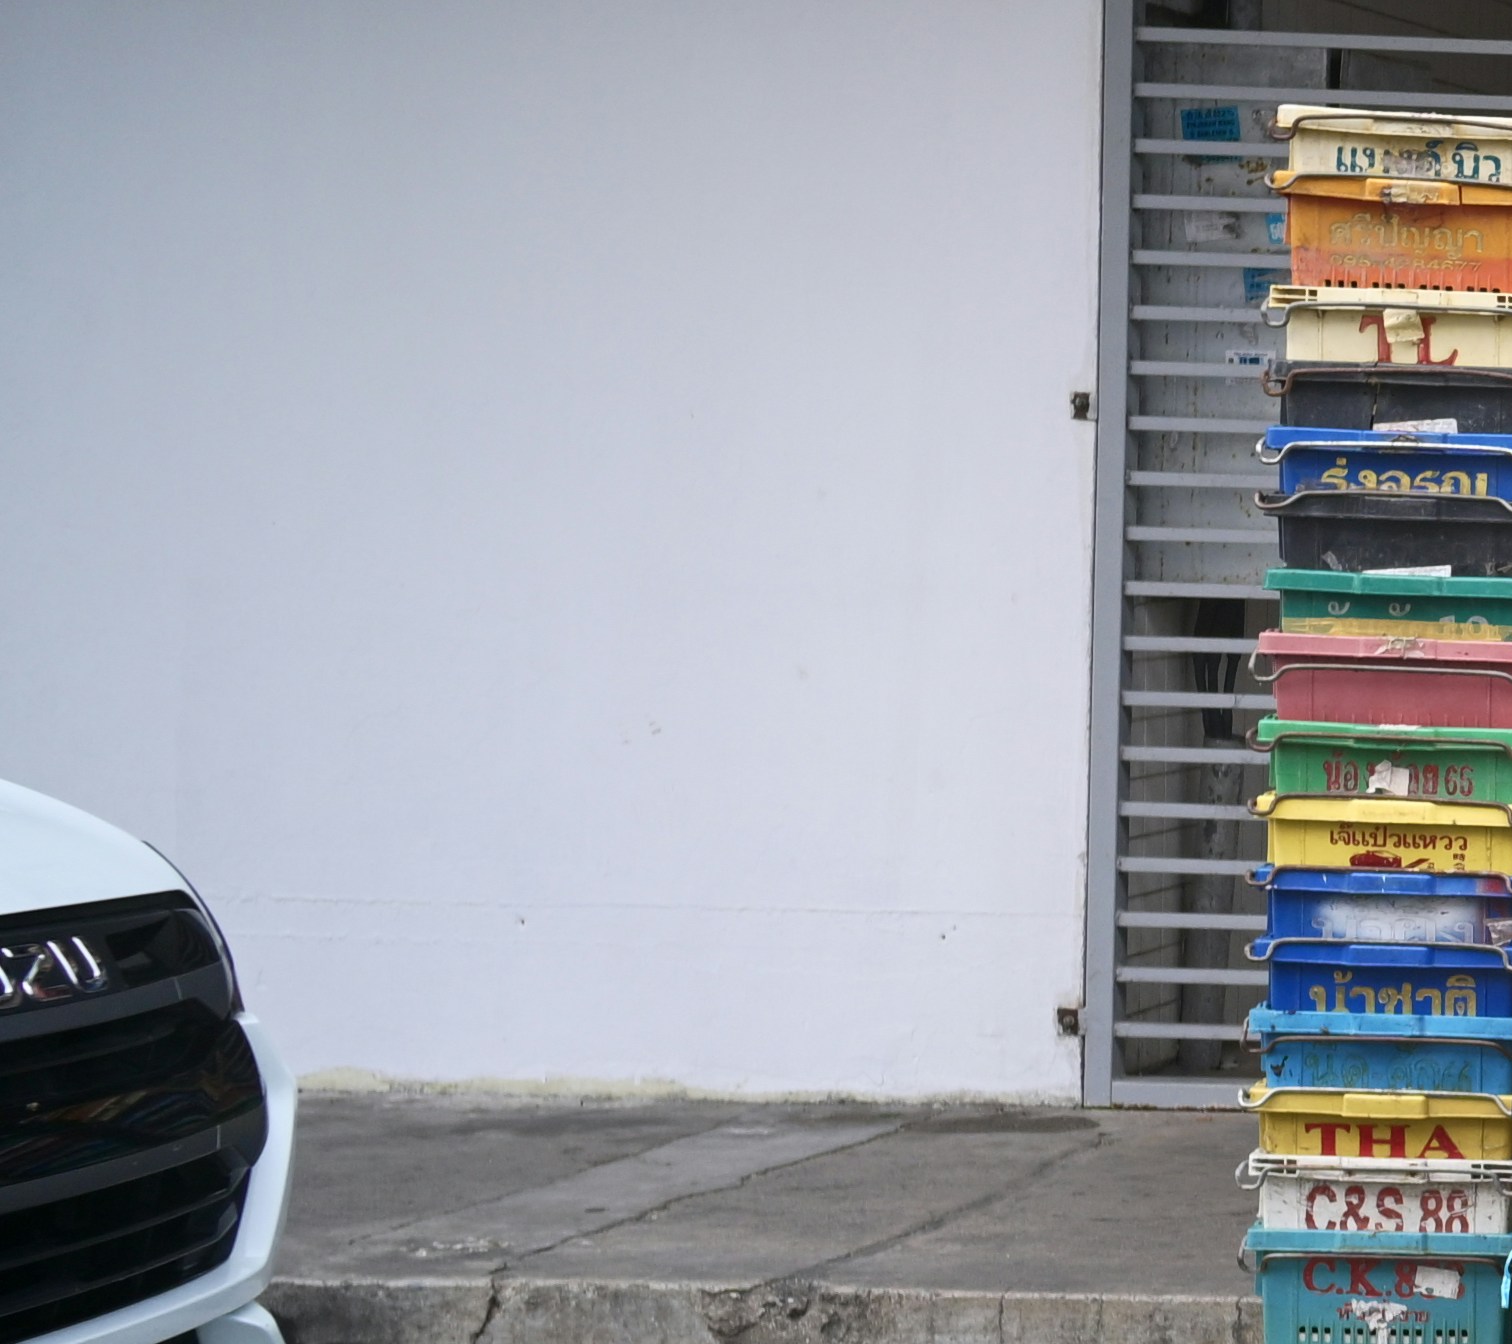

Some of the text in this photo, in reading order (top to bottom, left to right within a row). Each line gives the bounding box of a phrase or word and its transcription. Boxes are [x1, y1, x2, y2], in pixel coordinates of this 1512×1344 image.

[1445, 764, 1474, 797] 65
[1305, 1185, 1471, 1234] C&S 88
